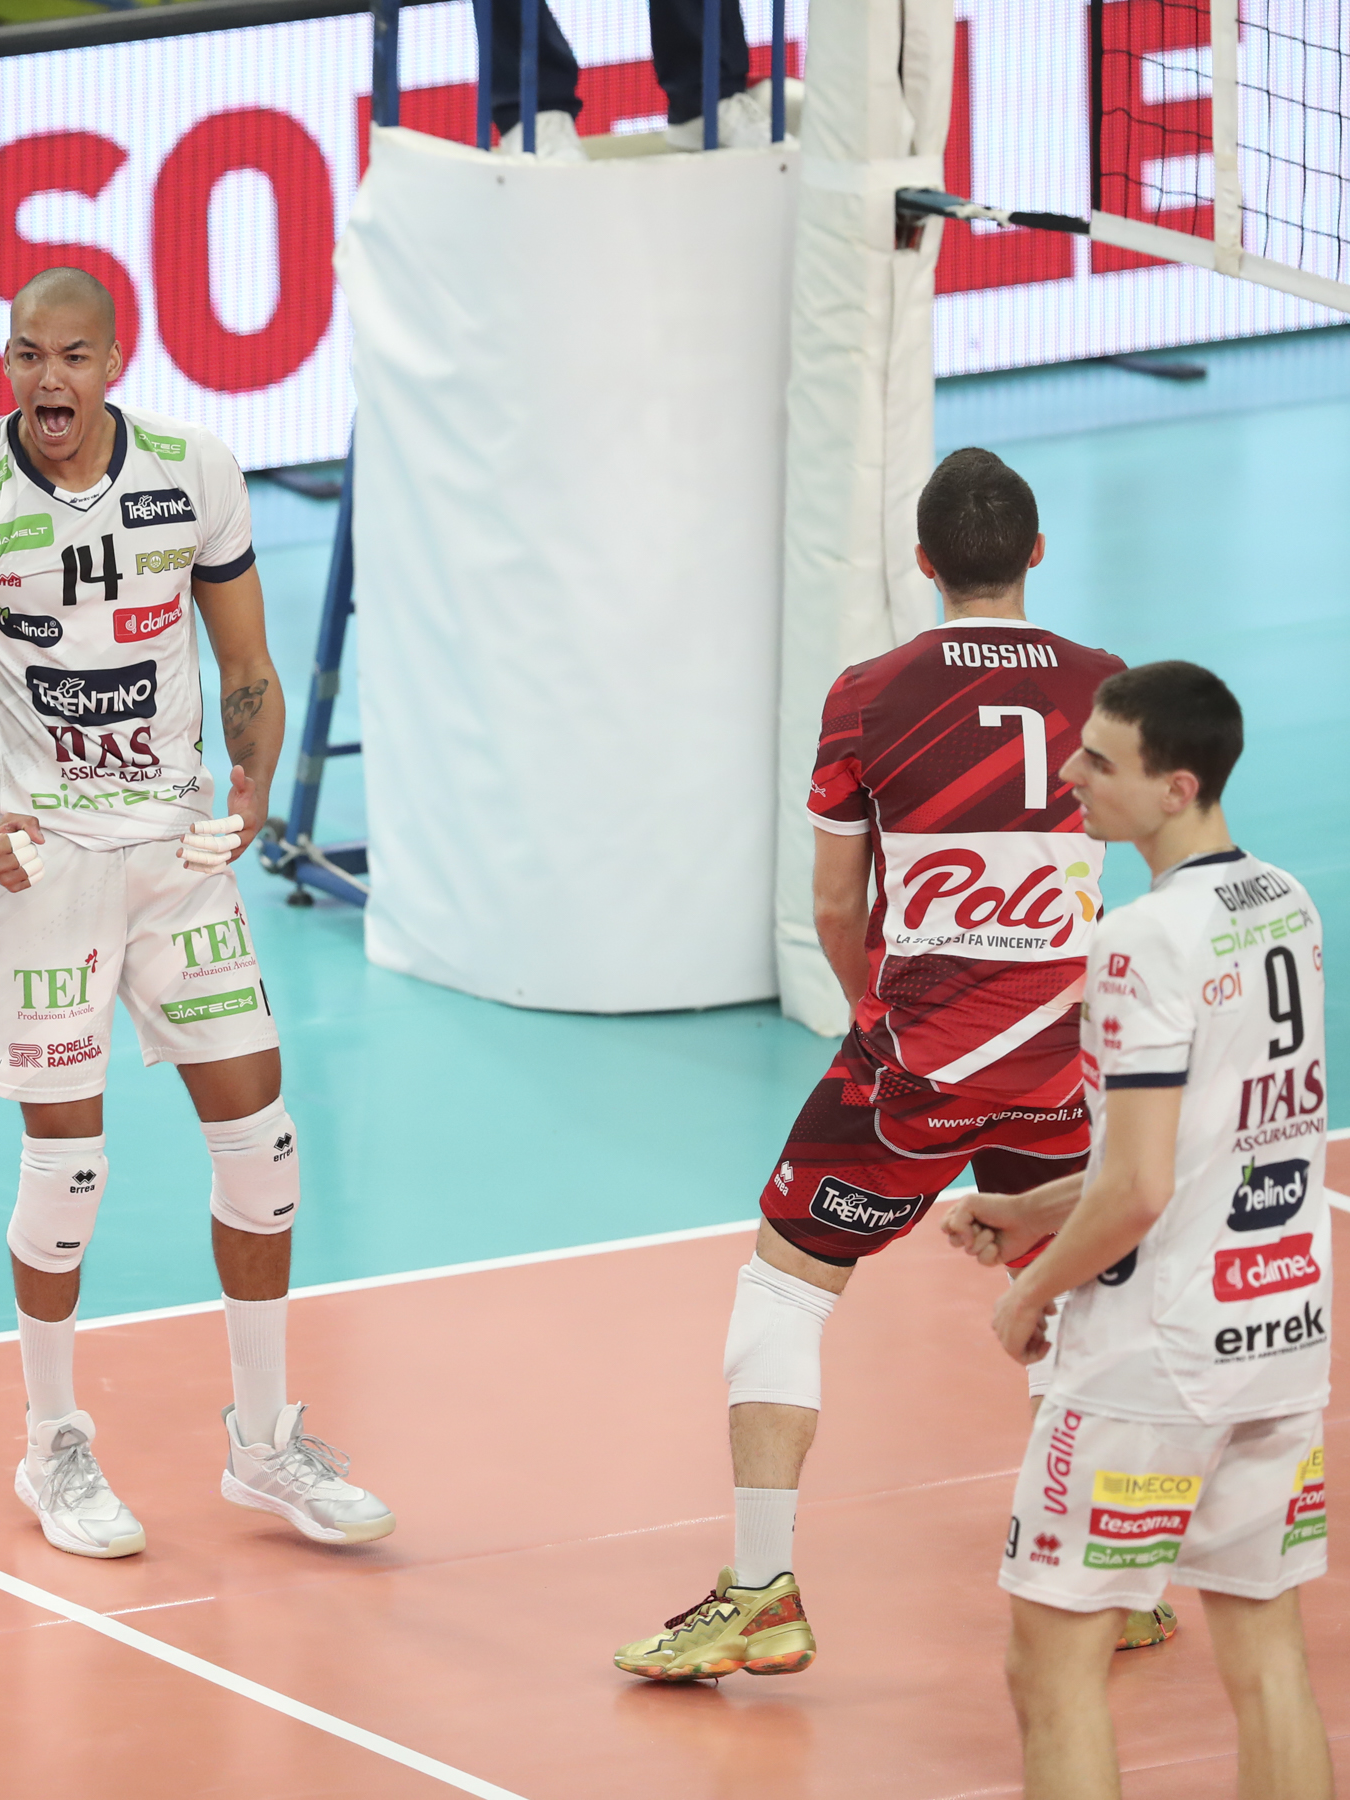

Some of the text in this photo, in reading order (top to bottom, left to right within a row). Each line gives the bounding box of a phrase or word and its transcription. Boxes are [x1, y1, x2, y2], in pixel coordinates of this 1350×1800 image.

[60, 533, 123, 606] 14
[135, 546, 197, 575] FORST
[941, 642, 1059, 668] ROSSINI
[978, 705, 1047, 809] 7
[1214, 871, 1292, 912] GIANNELLI
[171, 917, 251, 969] TEI
[968, 934, 984, 946] FA
[987, 935, 1048, 949] VINCENTE
[13, 965, 91, 1010] TEI
[181, 963, 232, 980] Produzioni
[17, 1004, 95, 1020] Produzioni Avicole
[1265, 946, 1305, 1061] 9
[47, 1035, 94, 1055] SORELLE
[47, 1046, 102, 1068] RAMONDA
[1235, 1059, 1325, 1133] ITAS
[69, 1184, 96, 1194] errea
[1215, 1300, 1326, 1356] errek
